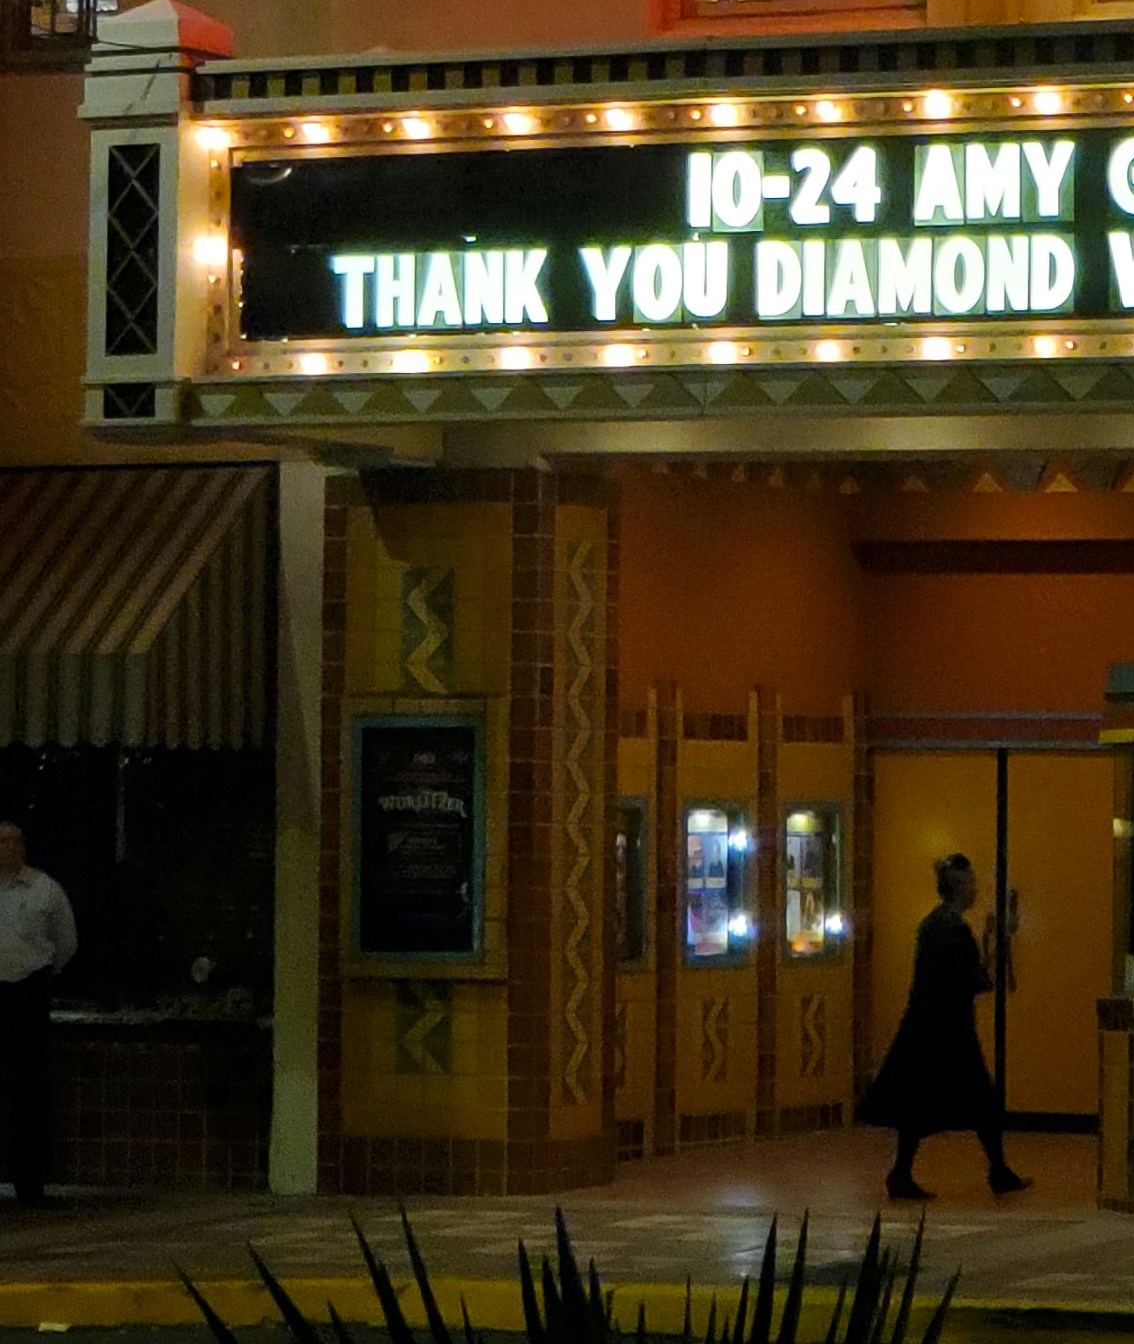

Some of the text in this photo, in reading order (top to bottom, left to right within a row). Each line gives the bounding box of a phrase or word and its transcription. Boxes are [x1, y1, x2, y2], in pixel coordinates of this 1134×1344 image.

[686, 146, 882, 228] 10-24
[915, 139, 1075, 223] AMY
[331, 247, 549, 330] THANK
[580, 240, 729, 323] YOU
[756, 233, 1075, 320] DIAMOND
